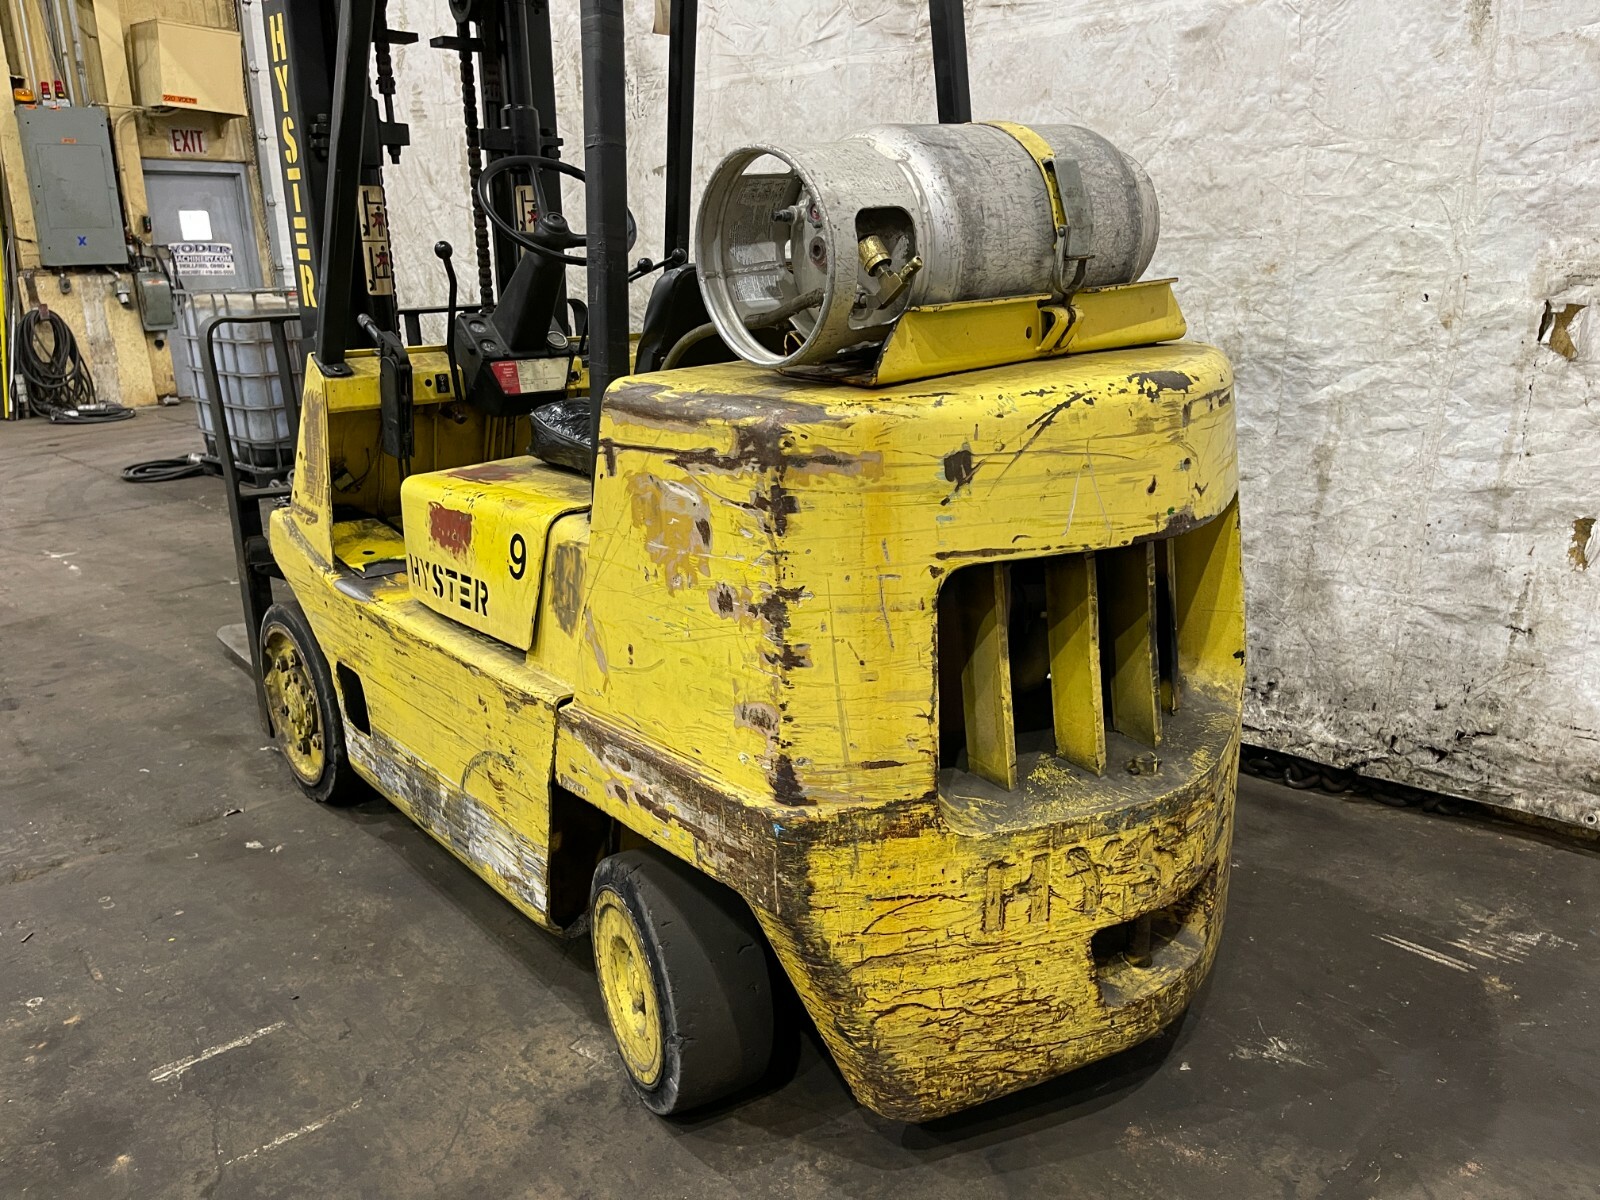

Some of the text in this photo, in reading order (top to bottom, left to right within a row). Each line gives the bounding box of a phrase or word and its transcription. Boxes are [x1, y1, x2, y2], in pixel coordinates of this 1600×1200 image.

[171, 129, 203, 153] EXIT
[269, 12, 317, 308] HYSTER
[175, 255, 233, 263] ACHINERY.COM
[509, 533, 526, 580] 9
[409, 553, 489, 617] HYSTER
